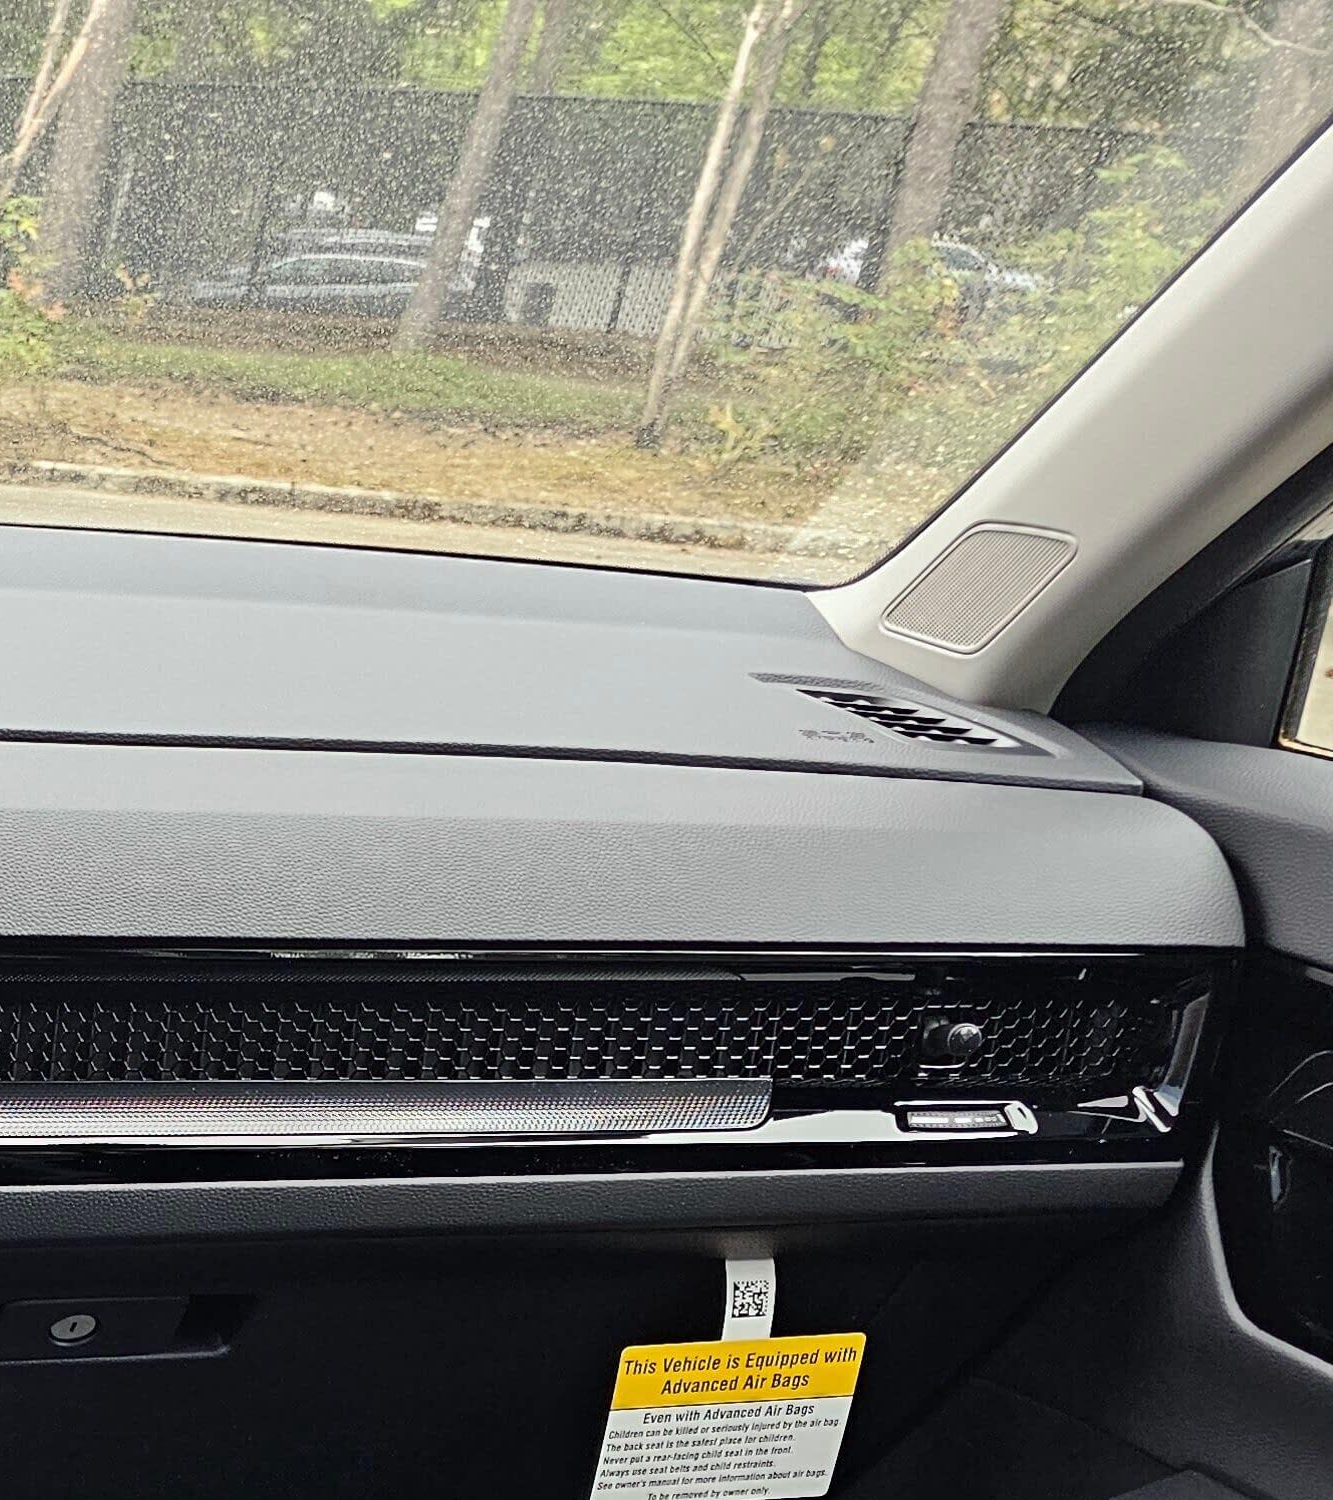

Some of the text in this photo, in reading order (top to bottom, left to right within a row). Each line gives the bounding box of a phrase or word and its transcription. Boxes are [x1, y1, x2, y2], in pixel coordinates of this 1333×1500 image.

[624, 1347, 857, 1375] This Vehicle is Equipped with
[661, 1373, 810, 1395] Advanced Air Bags
[643, 1404, 815, 1424] Even with Advanced Air Bags
[608, 1430, 643, 1440] Children
[663, 1428, 673, 1436] be
[676, 1426, 698, 1435] killed
[711, 1423, 748, 1433] seriously
[751, 1421, 780, 1432] injured
[782, 1420, 792, 1430] by
[794, 1420, 808, 1428] the
[810, 1419, 821, 1427] air
[606, 1444, 622, 1452] The
[624, 1443, 643, 1451] back
[645, 1441, 664, 1450] seat
[666, 1441, 674, 1449] is
[676, 1440, 689, 1448] the
[691, 1438, 717, 1447] safest
[719, 1437, 742, 1446] place
[603, 1457, 628, 1465] Never
[630, 1455, 643, 1465] put
[653, 1452, 700, 1462] rear-facing
[702, 1450, 723, 1459] child
[724, 1449, 743, 1457] seat
[597, 1482, 613, 1490] See
[615, 1480, 646, 1489] owner's
[648, 1477, 680, 1487] manual
[681, 1477, 693, 1485] for
[695, 1476, 716, 1484] more
[718, 1472, 765, 1482] information
[768, 1471, 791, 1480] about
[793, 1470, 804, 1478] air
[600, 1469, 629, 1478] Always
[632, 1468, 647, 1476] use
[649, 1466, 667, 1474] seat
[670, 1464, 690, 1473] belts
[692, 1463, 708, 1472] and
[710, 1462, 731, 1471] child
[648, 1493, 657, 1500] To
[659, 1492, 669, 1500] be
[672, 1490, 708, 1499] removed
[710, 1490, 720, 1498] by
[723, 1488, 749, 1497] owner
